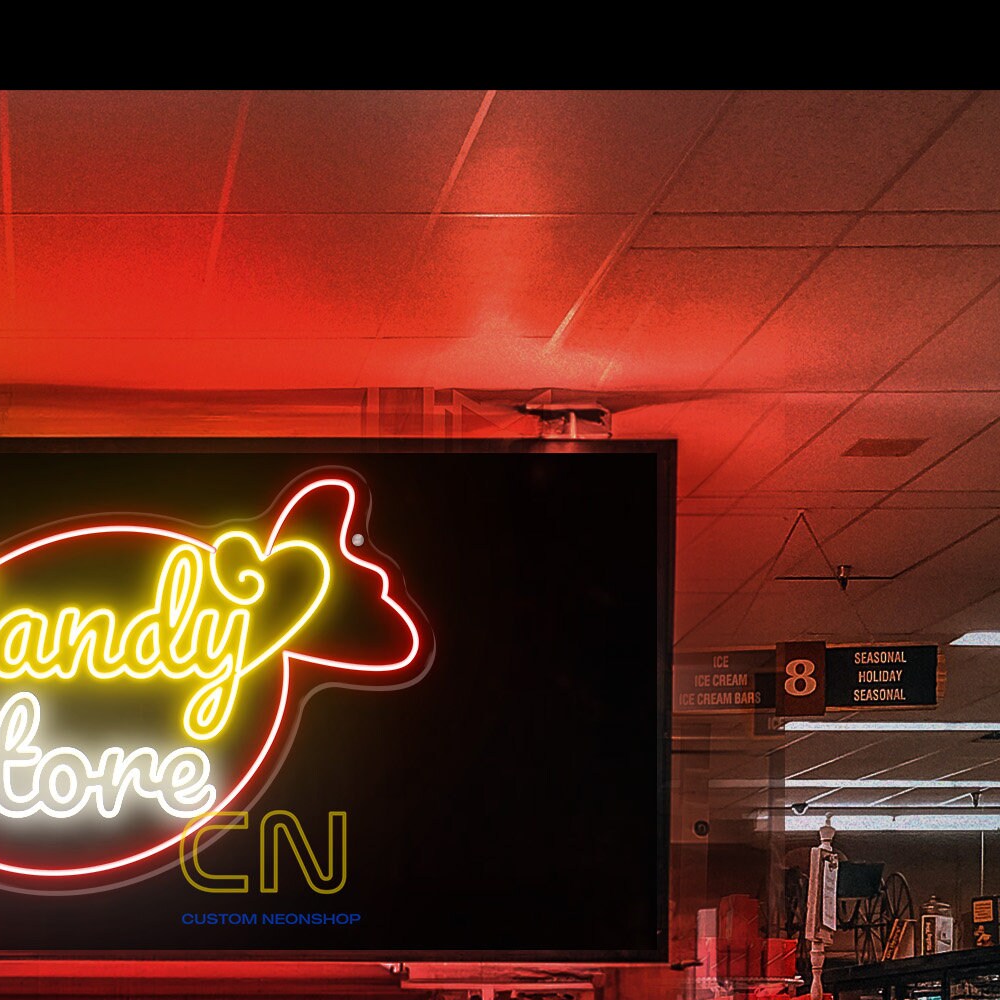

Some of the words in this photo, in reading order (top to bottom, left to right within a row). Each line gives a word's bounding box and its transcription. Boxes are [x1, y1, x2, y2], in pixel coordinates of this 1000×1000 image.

[713, 655, 729, 668] ICE
[854, 651, 907, 664] SEASONAL
[694, 674, 710, 687] ICE
[712, 673, 748, 686] CREAM
[784, 659, 817, 696] 8
[858, 669, 903, 683] HOLIDAY
[680, 692, 695, 705] ICE
[697, 692, 732, 705] CREAM
[734, 691, 761, 705] BARS
[853, 688, 906, 701] SEASONAL
